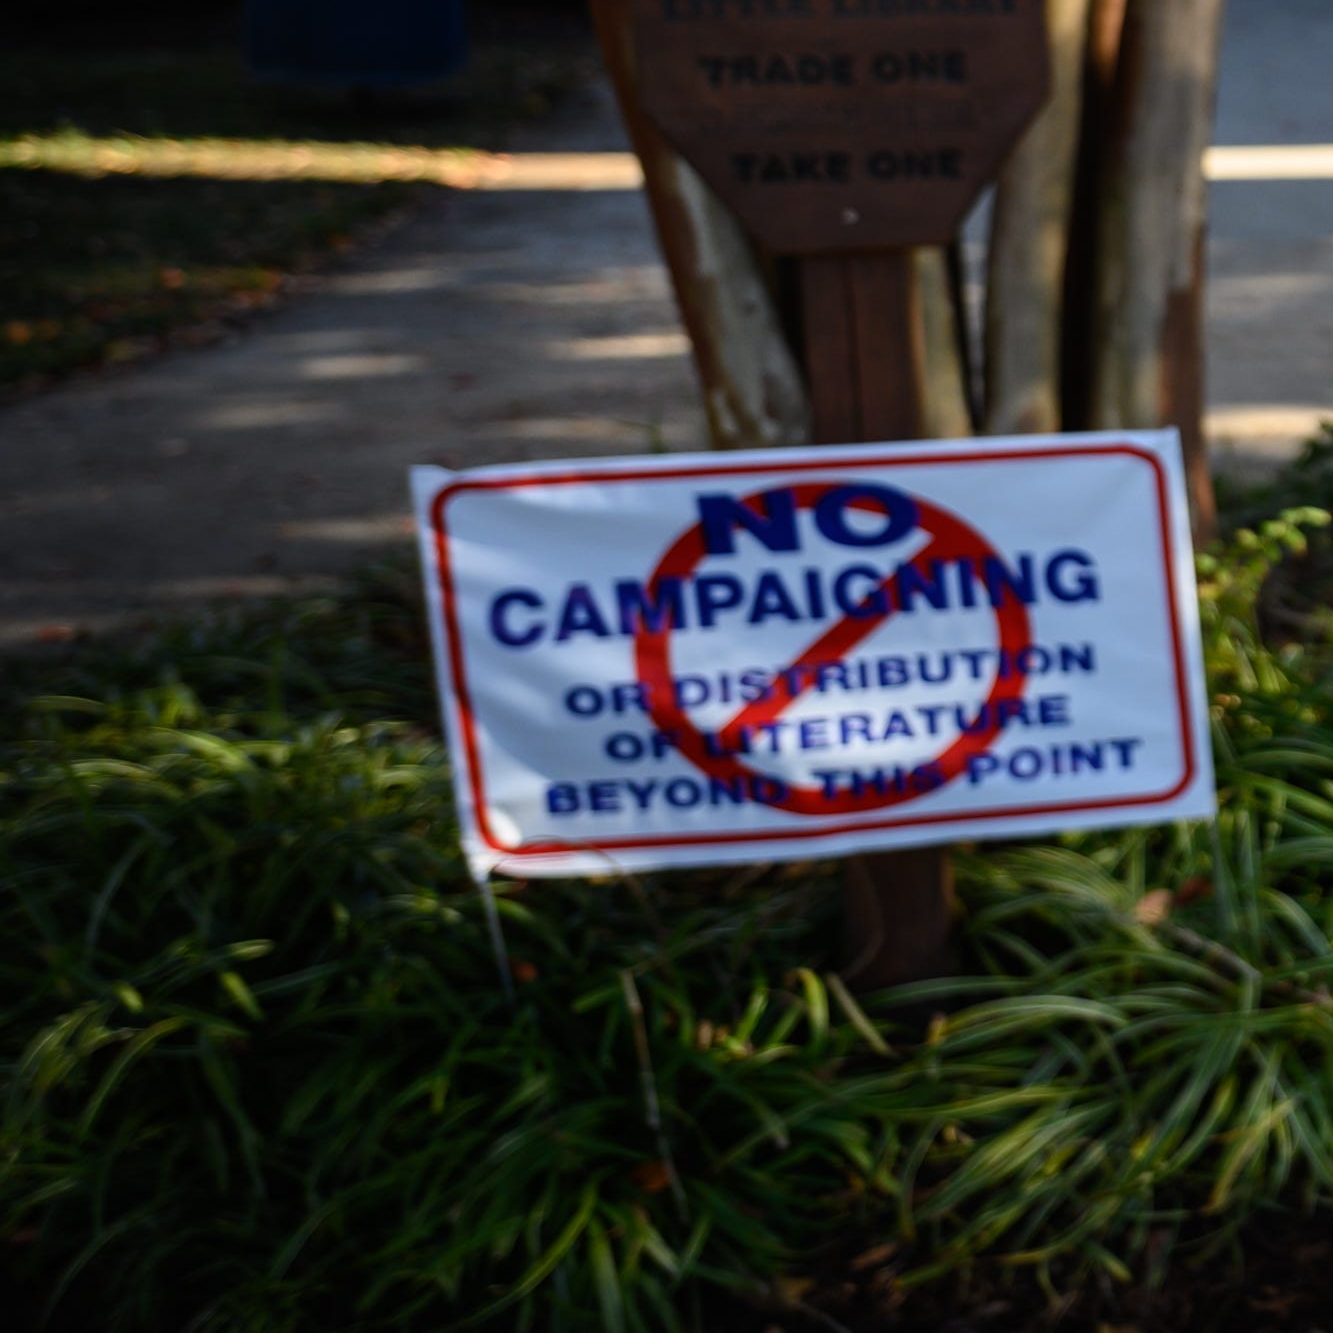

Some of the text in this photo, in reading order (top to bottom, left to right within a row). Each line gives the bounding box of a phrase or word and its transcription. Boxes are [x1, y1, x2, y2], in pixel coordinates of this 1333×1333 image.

[698, 50, 968, 88] TRADE ONE
[731, 148, 964, 185] TAKE ONE
[696, 481, 921, 555] NO
[489, 548, 1100, 648] CAMPAIGNING
[565, 642, 1097, 720] OR DISTRIBUTION
[605, 694, 1072, 762] OF LITERATURE
[545, 737, 1143, 815] BEYOND THIS POINT
